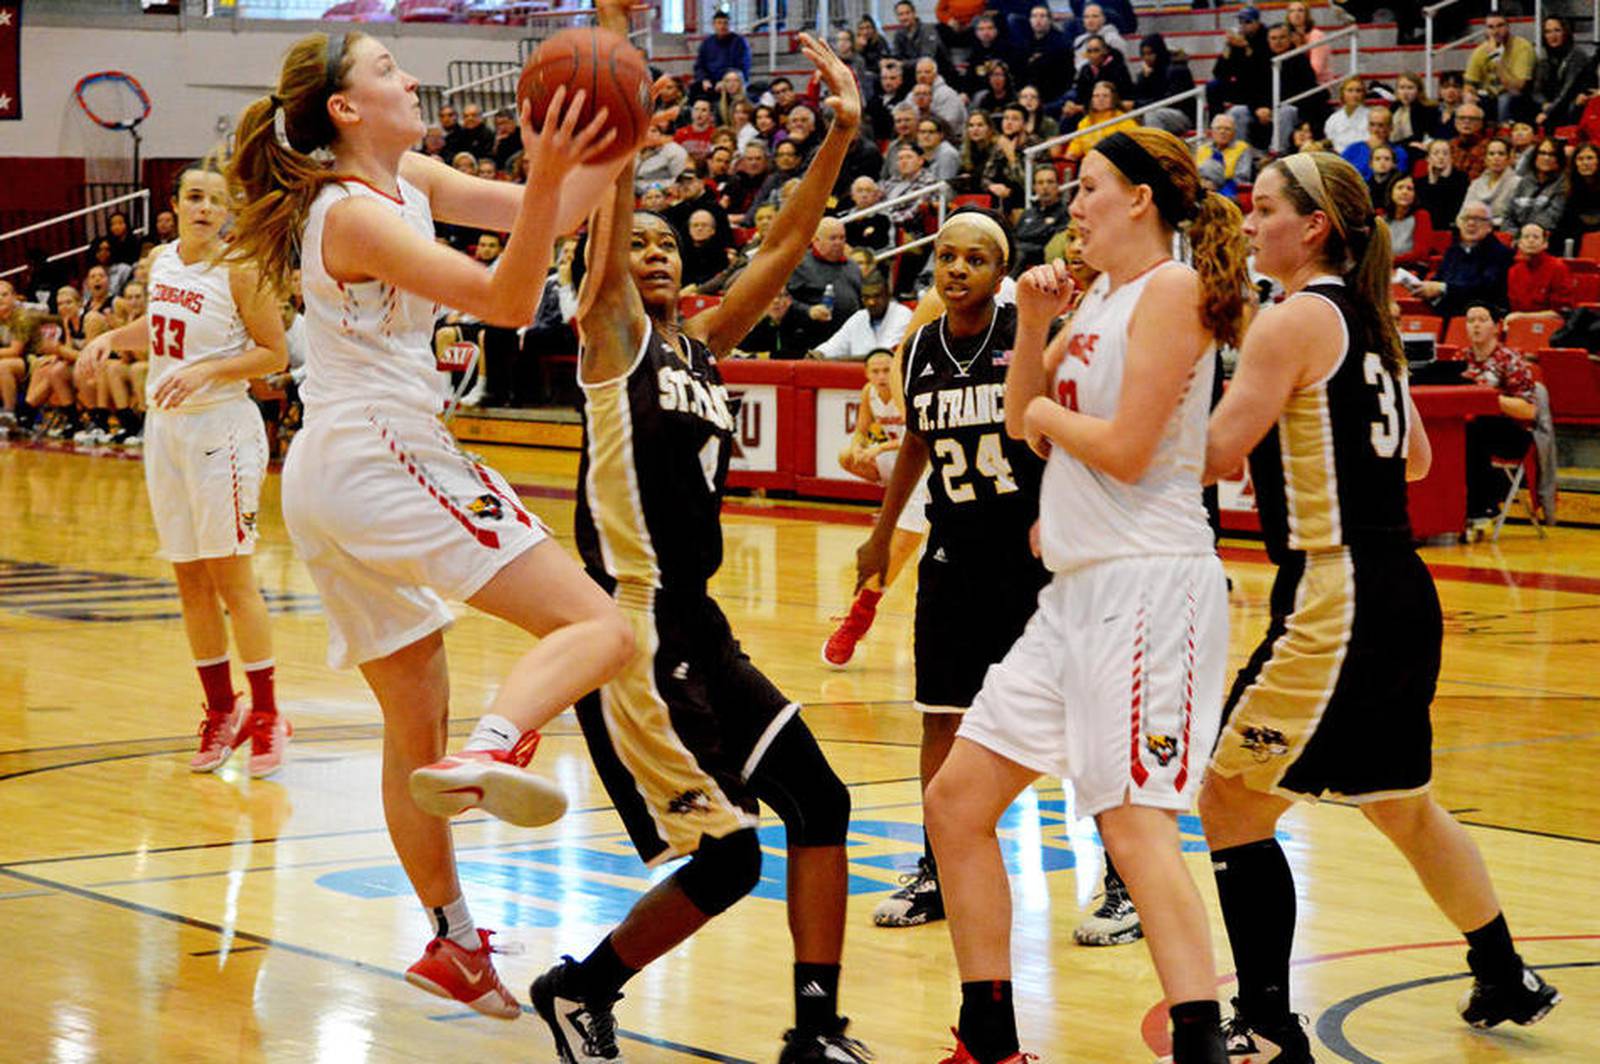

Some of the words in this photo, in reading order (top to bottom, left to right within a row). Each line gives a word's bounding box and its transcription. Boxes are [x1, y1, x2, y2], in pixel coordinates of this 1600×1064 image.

[152, 283, 205, 315] COUGARS
[152, 314, 187, 361] 33
[933, 432, 1020, 504] 24
